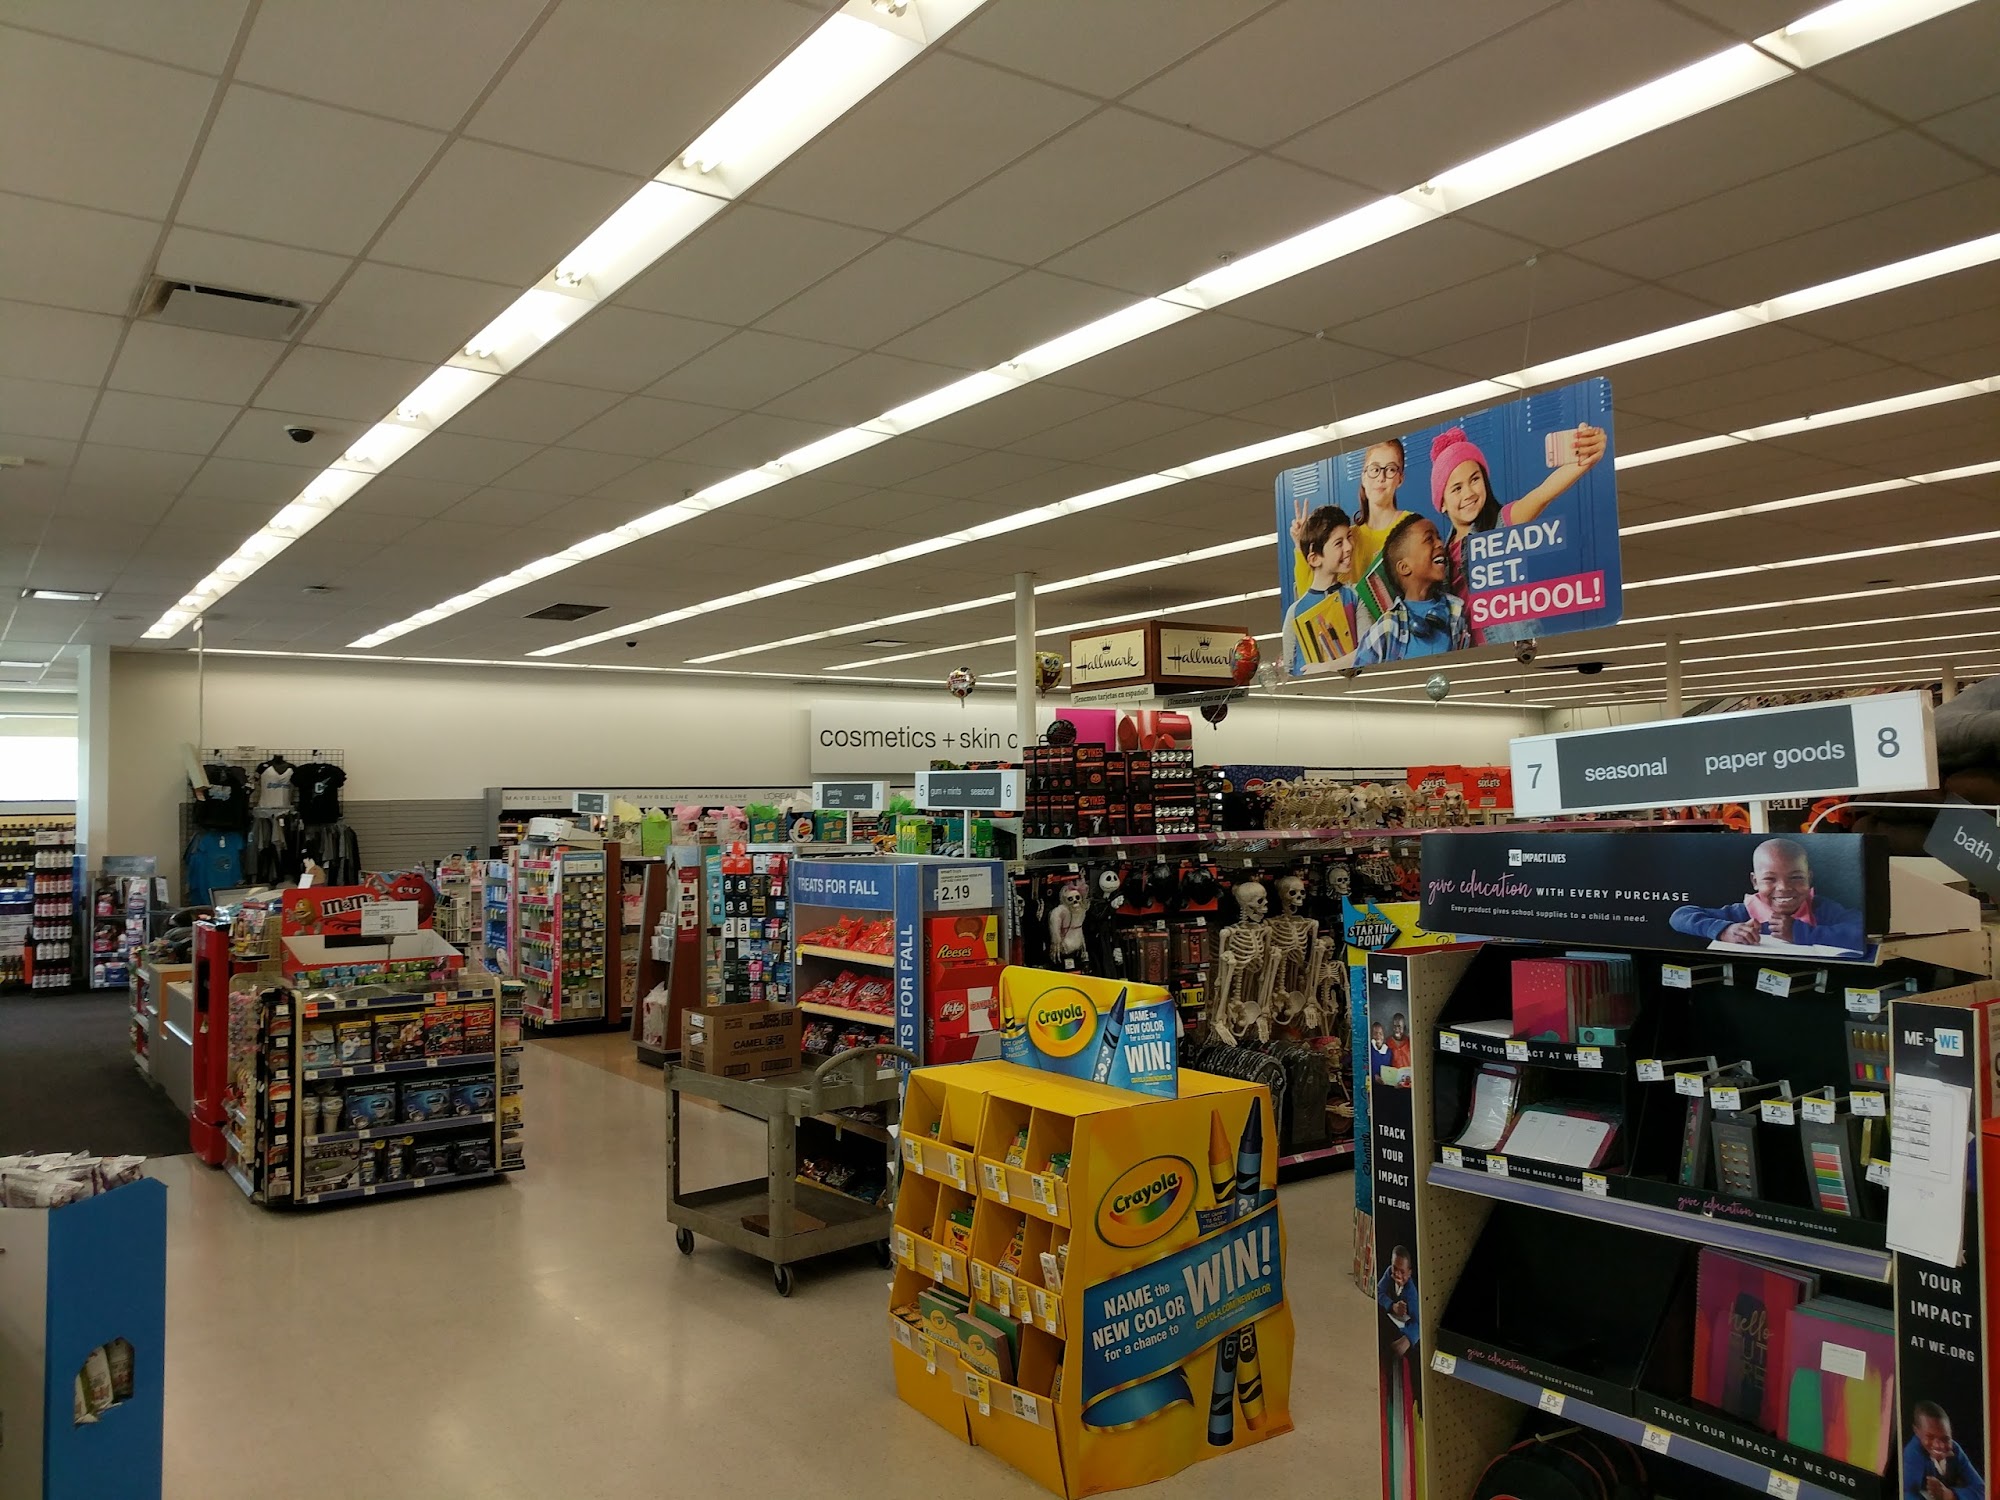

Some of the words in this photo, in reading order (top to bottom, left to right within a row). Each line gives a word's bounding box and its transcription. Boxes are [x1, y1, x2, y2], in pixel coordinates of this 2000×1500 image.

[1470, 520, 1562, 561] READY.
[1471, 558, 1525, 590] SET.
[1472, 578, 1601, 622] SCHOOL!
[1076, 648, 1139, 680] Hallmark
[820, 726, 936, 748] cosmetics
[960, 728, 1000, 748] skin
[1006, 733, 1050, 749] cre
[1526, 763, 1543, 789] 7
[1584, 757, 1668, 782] seasonal
[1704, 750, 1767, 775] paper
[1773, 741, 1846, 770] goods
[1876, 727, 1901, 758] 8
[854, 793, 866, 802] candy
[919, 784, 924, 797] 5
[930, 789, 942, 797] gum
[947, 788, 962, 796] mints
[970, 787, 994, 796] seasonal
[1006, 784, 1012, 798] 6
[1953, 825, 1994, 864] bath
[1522, 853, 1547, 864] IMPACT
[1547, 854, 1566, 864] LIVES
[798, 877, 824, 894] TREATS
[826, 879, 846, 894] FOR
[849, 880, 879, 896] FALL
[942, 885, 970, 900] 2.19
[1428, 878, 1456, 905] give
[1459, 869, 1532, 898] education
[1536, 887, 1565, 897] WITH
[1570, 888, 1610, 899] EVERY
[1615, 890, 1690, 902] PURCHASE
[1450, 904, 1467, 913] Every
[1468, 906, 1492, 915] product
[1492, 908, 1510, 916] gives
[1511, 908, 1534, 917] school
[1536, 910, 1568, 920] supplies
[1588, 912, 1610, 921] child
[1624, 914, 1648, 923] need.
[1349, 924, 1396, 937] STARTING
[1357, 934, 1388, 947] POINT
[901, 925, 914, 971] FALL
[937, 944, 972, 958] Reese's
[1372, 973, 1384, 984] ME
[1389, 974, 1400, 985] WE
[901, 976, 914, 1018] FOR
[1038, 1004, 1083, 1024] Crayola
[1129, 1010, 1149, 1022] NAME
[1125, 1024, 1140, 1035] NEW
[1141, 1020, 1164, 1034] COLOR
[734, 1038, 764, 1050] CAMEL
[1904, 1030, 1924, 1046] ME
[1939, 1034, 1960, 1050] WE
[1124, 1040, 1172, 1074] WIN!
[1481, 1044, 1504, 1054] YOUR
[1549, 1052, 1560, 1060] AT
[1378, 1124, 1406, 1140] TRACK
[1382, 1148, 1404, 1164] YOUR
[1378, 1169, 1409, 1188] IMPACT
[1532, 1170, 1556, 1180] MAKES
[1113, 1172, 1178, 1213] Crayola
[1378, 1195, 1386, 1204] AT
[1386, 1197, 1411, 1212] WE.ORG
[1678, 1195, 1700, 1210] give
[1702, 1196, 1754, 1218] education
[1755, 1213, 1773, 1221] WITH
[1775, 1216, 1798, 1226] EVERY
[1800, 1222, 1838, 1234] PURCHASE
[1182, 1226, 1272, 1316] WIN!
[1919, 1270, 1962, 1295] YOUR
[1104, 1284, 1154, 1319] NAME
[1154, 1282, 1170, 1297] the
[1092, 1318, 1130, 1350] NEW
[1134, 1295, 1186, 1334] COLOR
[1911, 1300, 1972, 1329] IMPACT
[1104, 1348, 1122, 1362] for
[1124, 1344, 1132, 1355] a
[1133, 1330, 1168, 1352] chance
[1168, 1324, 1180, 1336] to
[1911, 1335, 1926, 1348] AT
[1929, 1340, 1975, 1362] WE.ORG
[1488, 1354, 1530, 1374] education
[1564, 1381, 1595, 1396] PURCHASE
[1654, 1406, 1690, 1427] TRACK
[1695, 1422, 1726, 1440] YOUR
[1731, 1434, 1776, 1458] IMPACT
[1782, 1454, 1798, 1466] AT
[1804, 1461, 1856, 1488] WE.ORG
